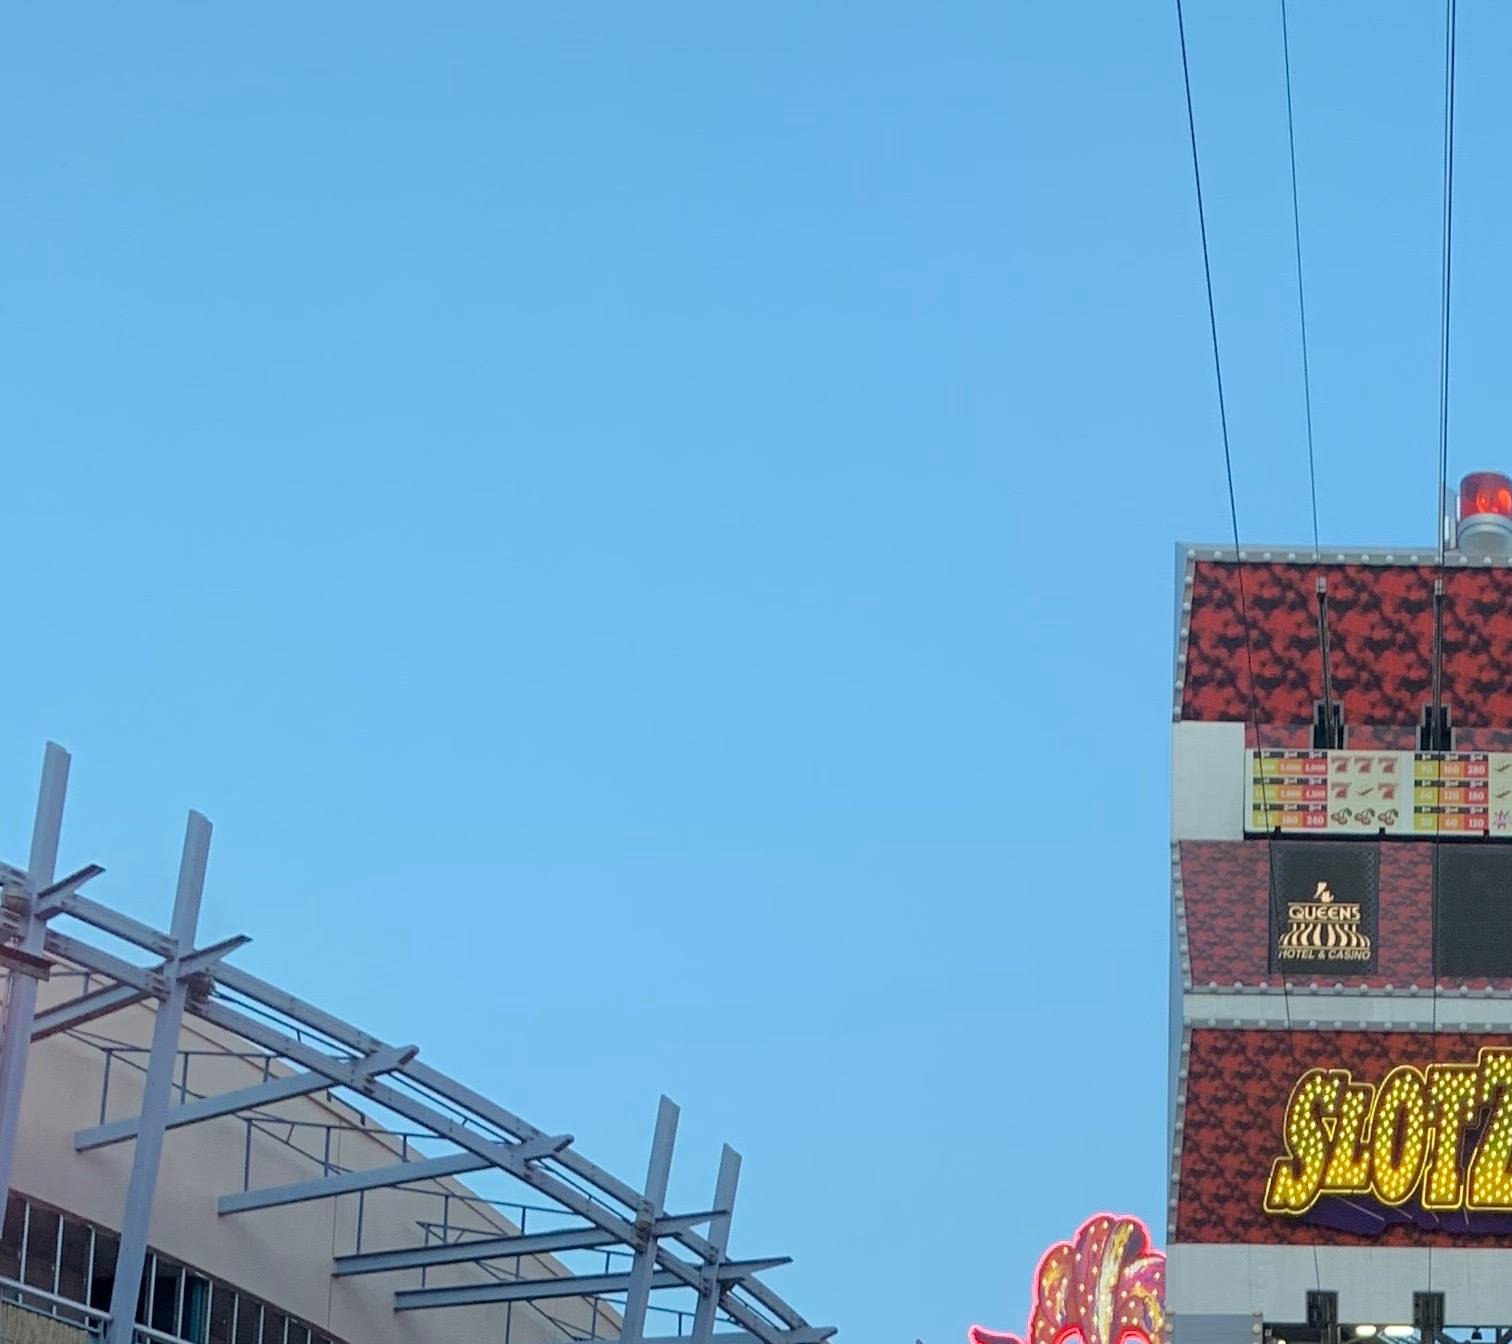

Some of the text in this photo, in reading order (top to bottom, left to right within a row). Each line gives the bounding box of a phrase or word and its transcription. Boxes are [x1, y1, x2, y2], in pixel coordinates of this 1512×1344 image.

[1306, 815, 1325, 826] 240
[1288, 906, 1361, 921] QUEENS
[1278, 949, 1315, 960] HOTEL
[1328, 950, 1371, 961] CASINO
